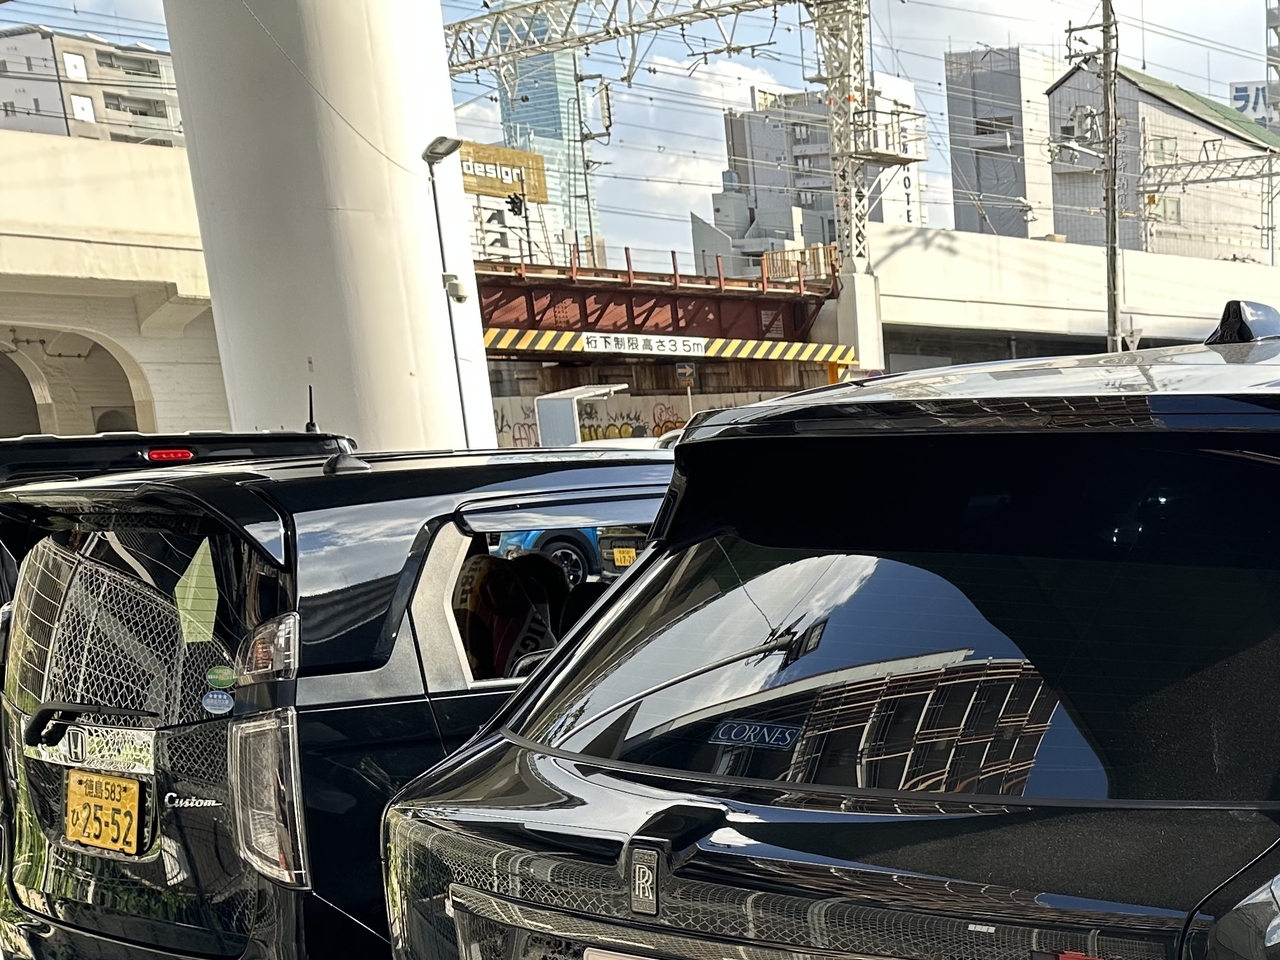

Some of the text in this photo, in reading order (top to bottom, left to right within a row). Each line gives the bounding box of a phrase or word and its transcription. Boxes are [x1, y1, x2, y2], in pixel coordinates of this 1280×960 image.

[462, 158, 524, 184] design
[718, 723, 796, 746] CORNES
[84, 778, 122, 803] 徳島583
[164, 792, 223, 809] Custom
[82, 802, 133, 848] 25-52
